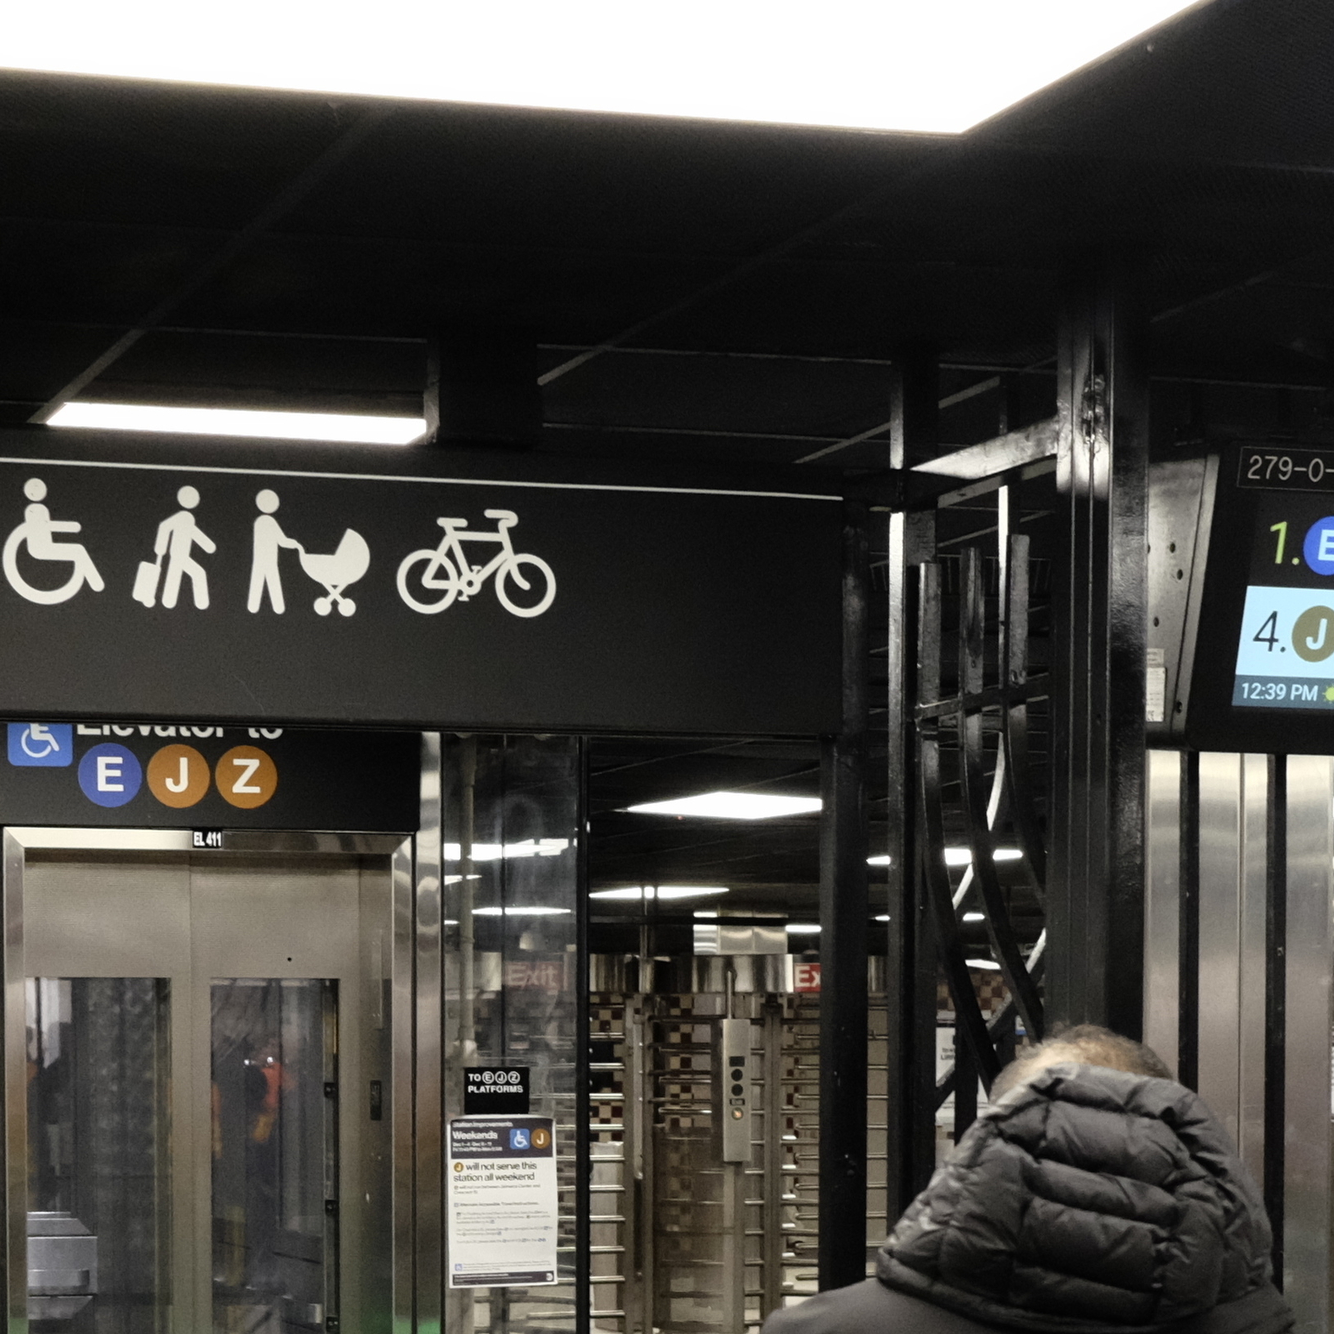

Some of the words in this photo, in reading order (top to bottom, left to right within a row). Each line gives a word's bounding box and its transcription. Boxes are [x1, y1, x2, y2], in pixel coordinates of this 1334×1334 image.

[1241, 682, 1286, 700] 12:39
[1290, 684, 1318, 701] PM
[194, 832, 205, 847] EL
[206, 832, 222, 847] 411
[795, 965, 821, 988] Ex
[467, 1073, 482, 1082] TO
[467, 1085, 524, 1093] PLATFORMS
[452, 1131, 498, 1140] Weekends
[521, 1161, 537, 1170] this
[454, 1173, 483, 1181] station
[484, 1173, 494, 1181] all
[495, 1173, 535, 1181] weekend
